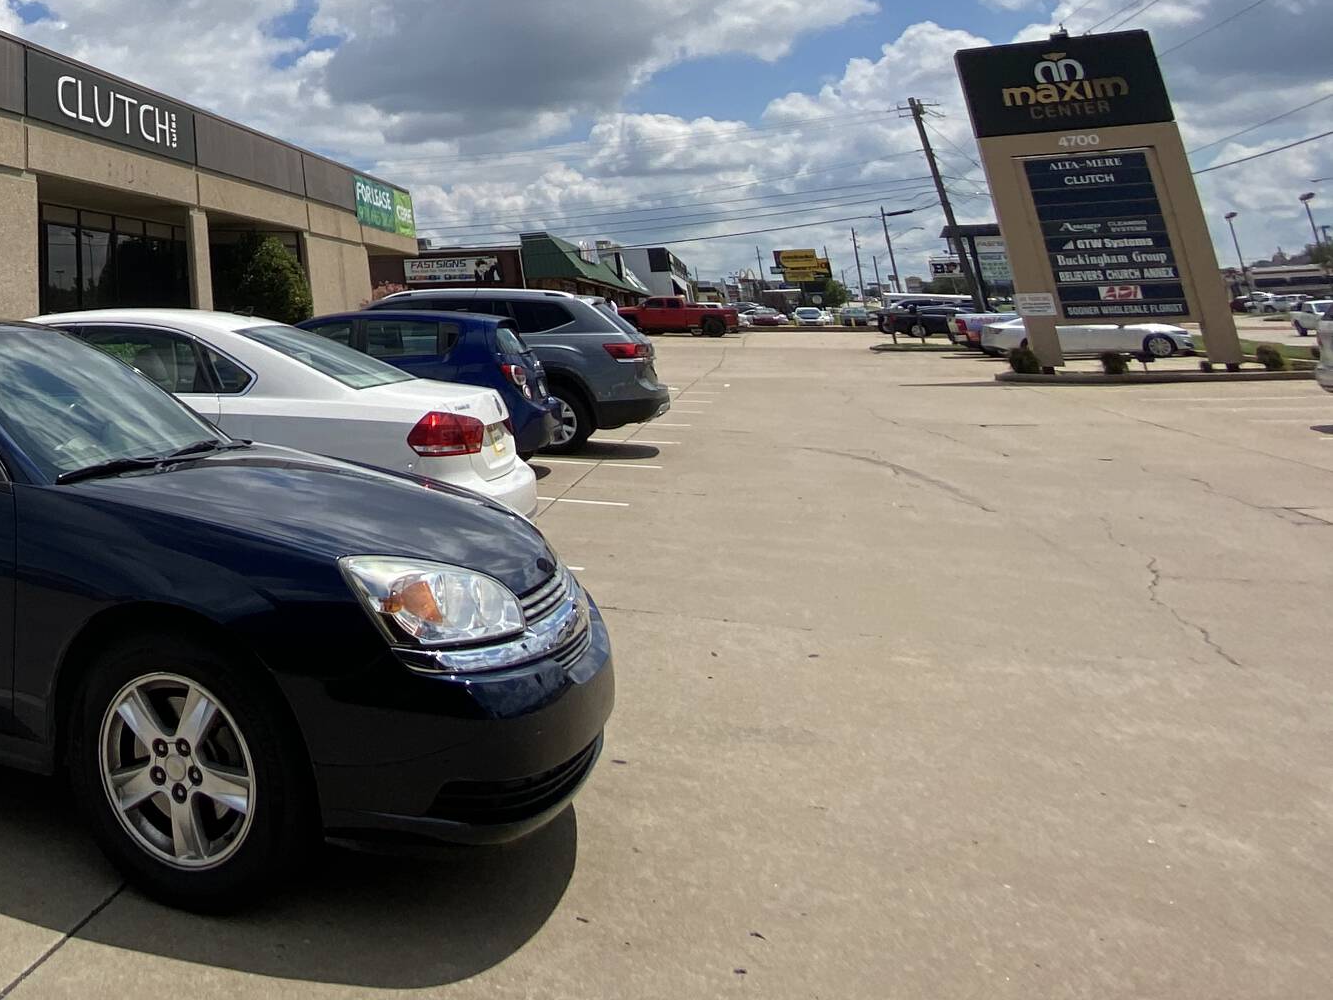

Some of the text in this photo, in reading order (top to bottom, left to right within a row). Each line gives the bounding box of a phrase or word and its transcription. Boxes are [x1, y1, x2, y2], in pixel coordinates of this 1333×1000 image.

[1002, 77, 1130, 107] maxim
[57, 75, 170, 147] CLUTCH
[1030, 100, 1111, 119] CENTER
[1058, 134, 1100, 147] 4700
[1049, 157, 1123, 170] ALTA-MERE
[1064, 173, 1115, 185] CLUTCH
[356, 182, 392, 210] FOR LEASE
[1104, 237, 1154, 249] Systems
[410, 260, 466, 269] FASTSIGNS
[1056, 251, 1167, 267] Buckingham Group
[1058, 270, 1104, 282] BELIEVERS
[1106, 268, 1141, 280] CHURCH
